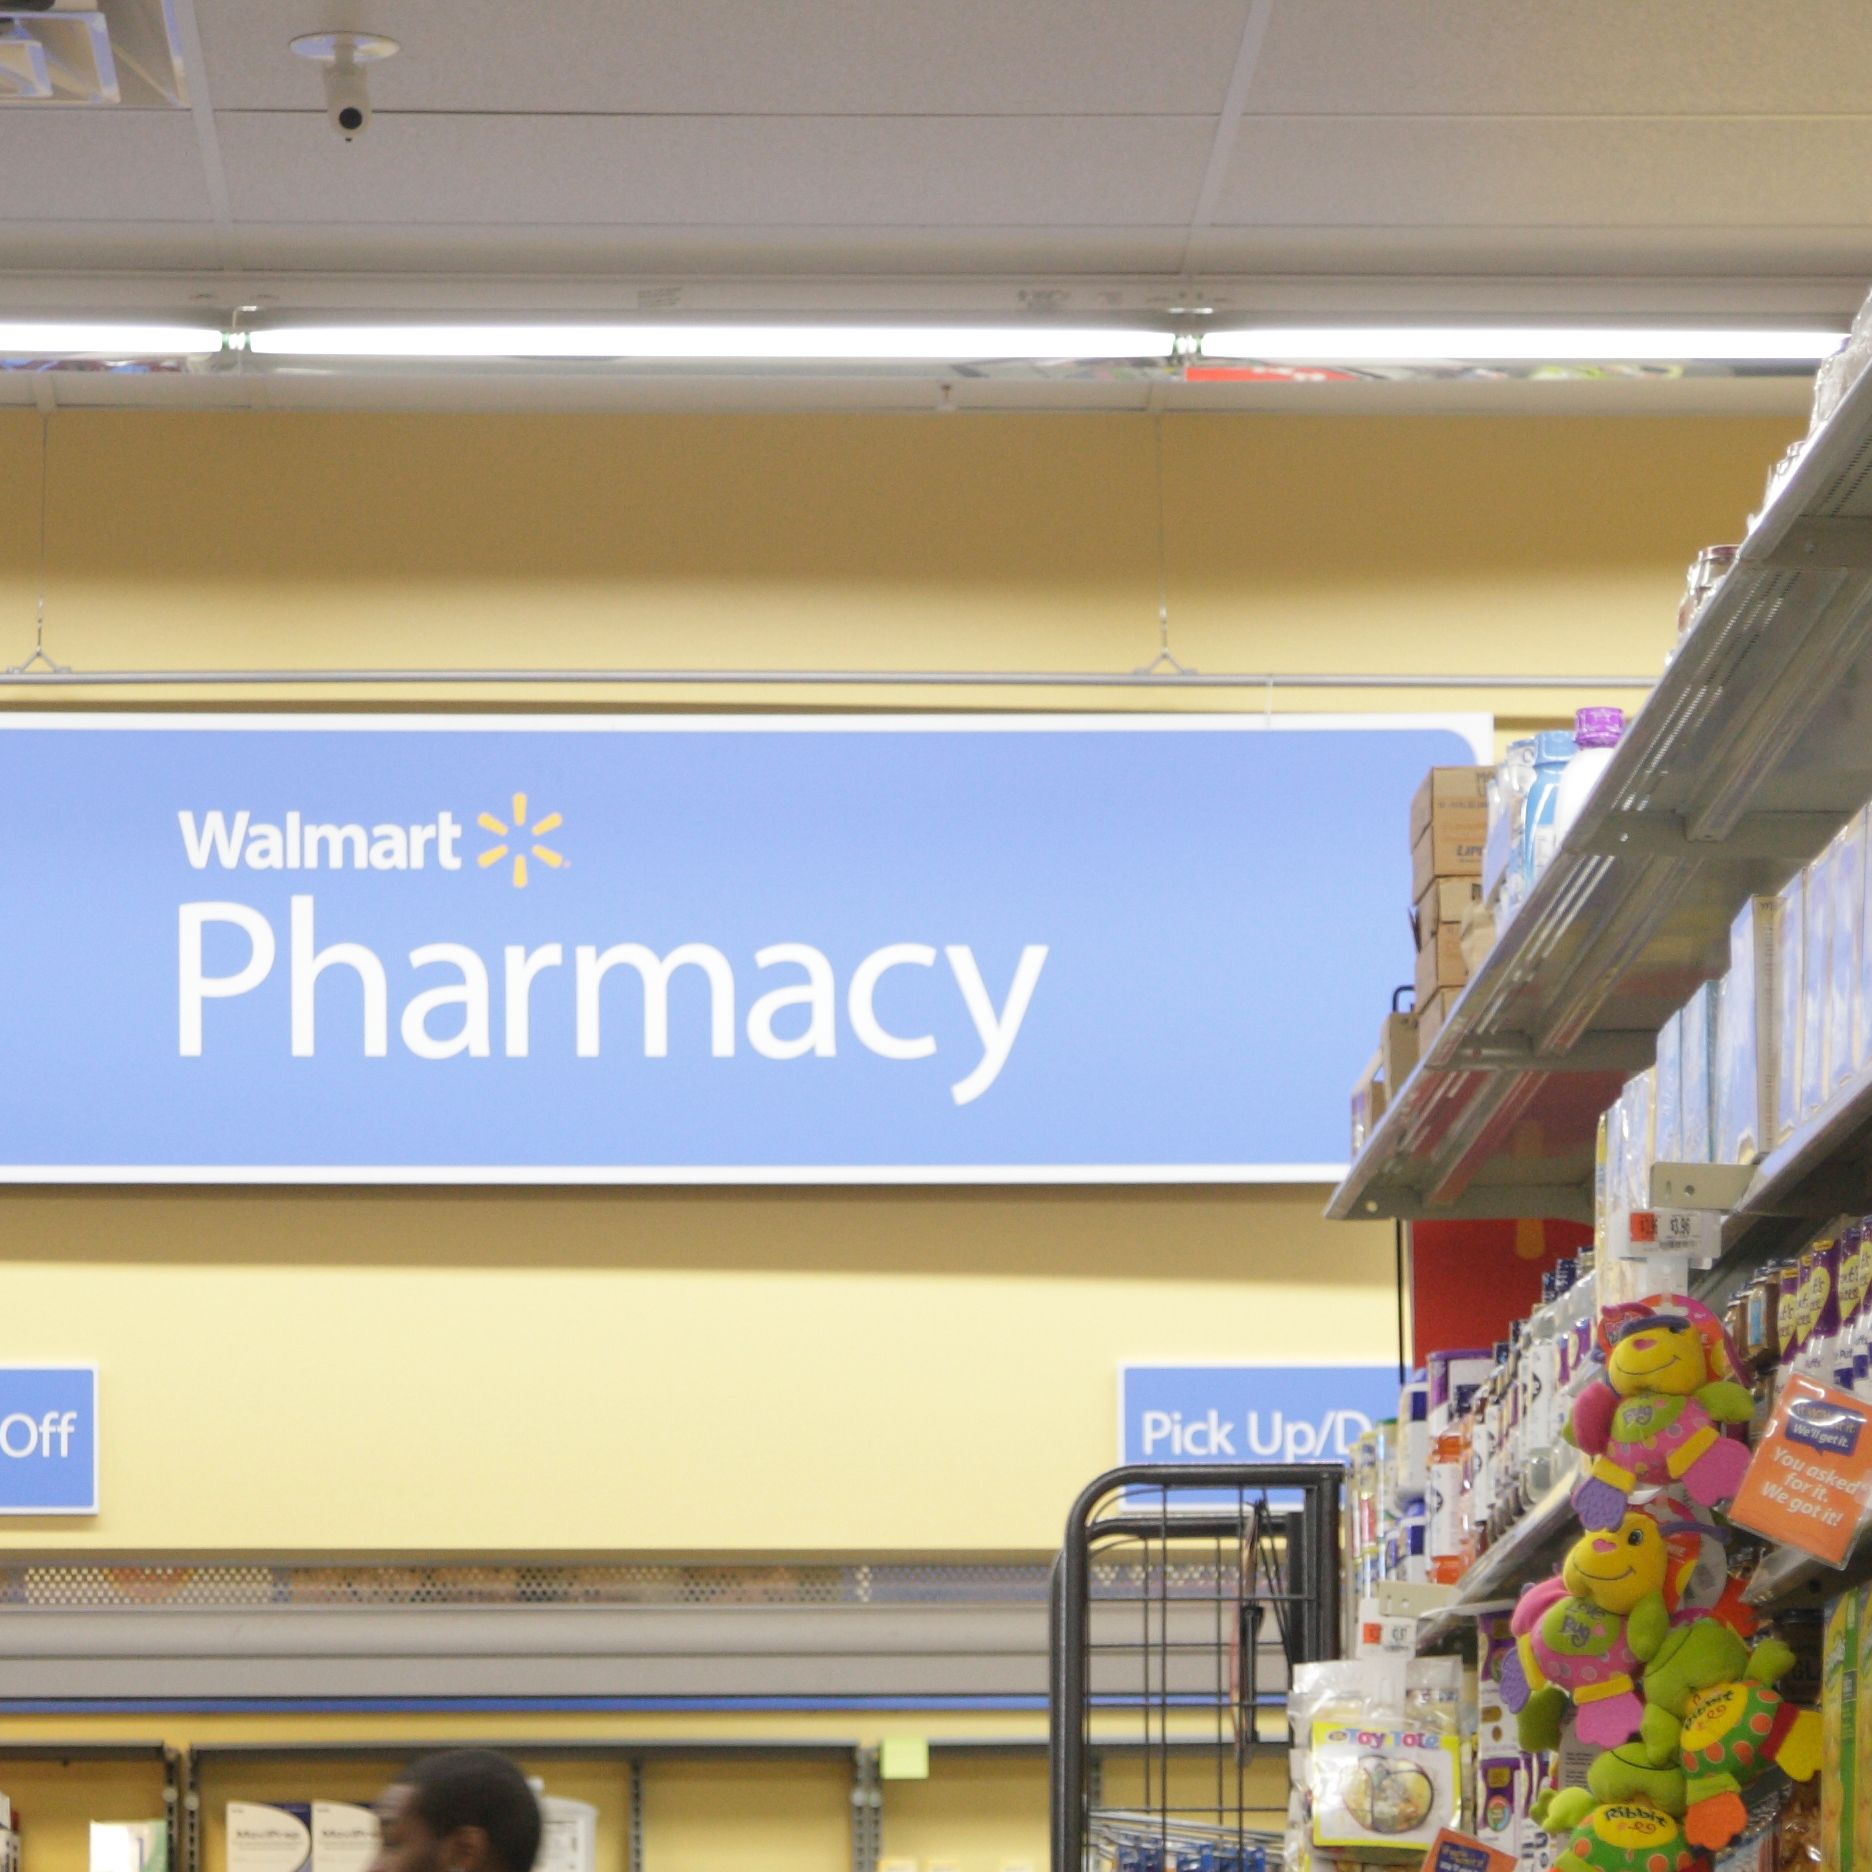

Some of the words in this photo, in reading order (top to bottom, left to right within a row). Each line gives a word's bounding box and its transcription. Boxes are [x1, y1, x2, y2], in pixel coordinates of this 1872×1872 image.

[177, 811, 462, 870] Walmart
[177, 894, 1049, 1105] Pharmacy
[0, 1411, 78, 1458] Off
[1142, 1409, 1236, 1456] Pick
[1774, 1446, 1805, 1472] You
[1806, 1463, 1861, 1495] asked
[1784, 1472, 1809, 1494] for
[1813, 1485, 1829, 1503] it.
[1760, 1481, 1788, 1504] We
[1787, 1496, 1820, 1518] got
[1822, 1509, 1844, 1527] it!
[1345, 1728, 1385, 1749] Toy
[1392, 1729, 1440, 1748] Tote
